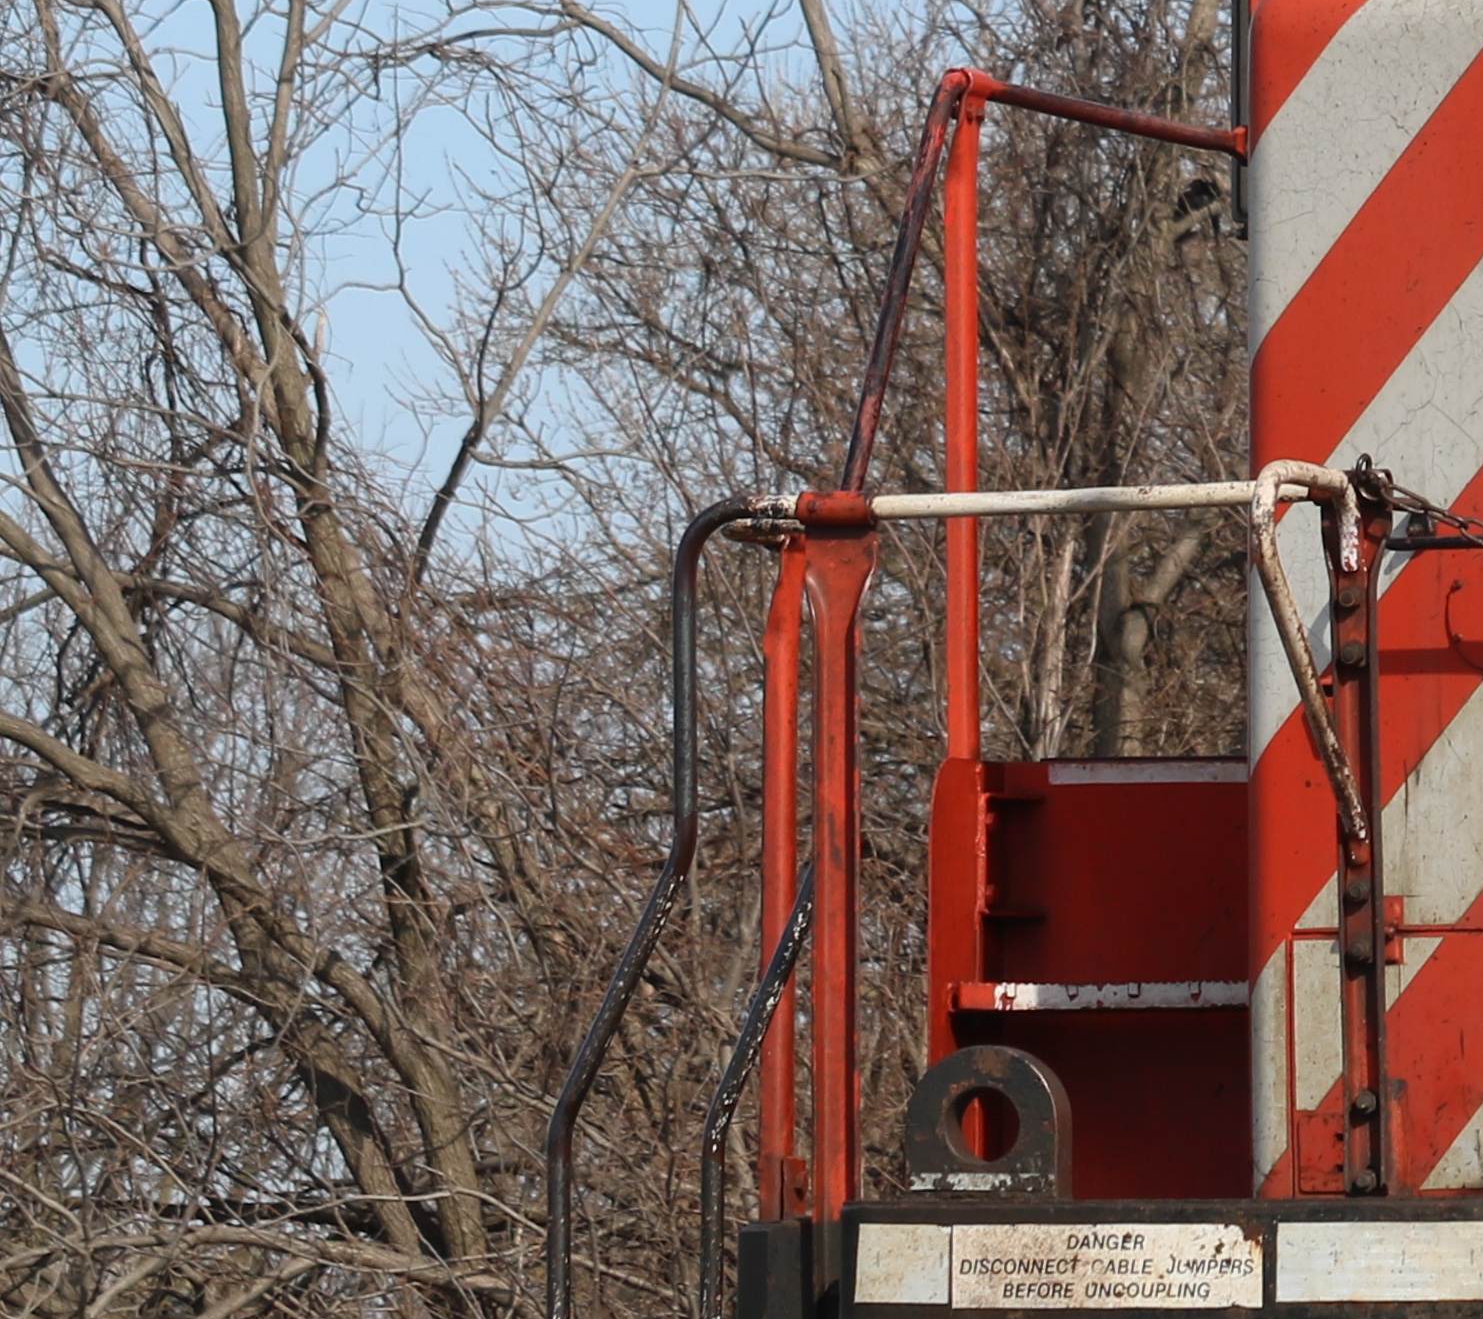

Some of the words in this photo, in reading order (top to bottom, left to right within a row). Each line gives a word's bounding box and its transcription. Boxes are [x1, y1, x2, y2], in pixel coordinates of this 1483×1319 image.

[1066, 1232, 1146, 1251] DANGER
[958, 1256, 1081, 1276] DISCONNECT
[1090, 1258, 1154, 1276] CABLE
[1165, 1255, 1255, 1277] JUMPERS
[1002, 1281, 1075, 1300] BEFORE
[1084, 1281, 1212, 1300] UNCOUPLING
